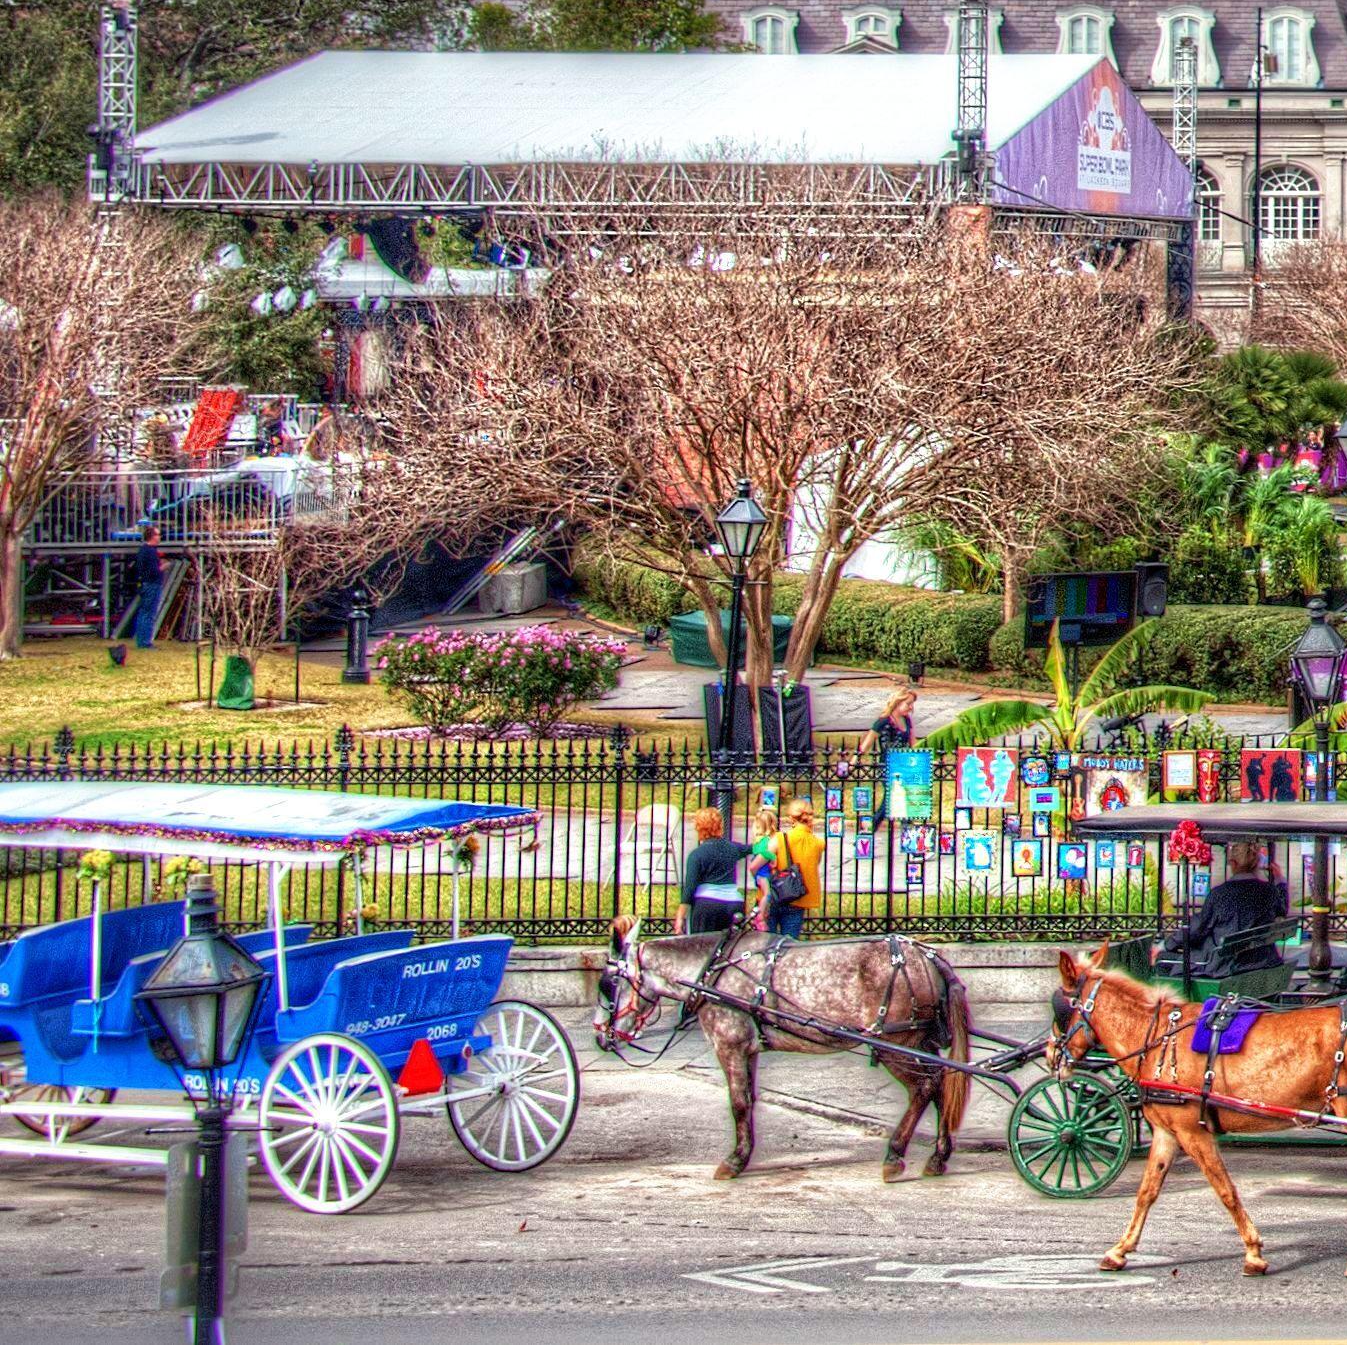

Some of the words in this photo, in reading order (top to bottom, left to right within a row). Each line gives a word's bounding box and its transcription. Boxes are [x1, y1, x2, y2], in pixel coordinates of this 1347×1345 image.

[402, 958, 450, 978] ROLLIN
[455, 954, 482, 971] 20'S
[426, 1022, 458, 1041] 2068
[184, 1073, 228, 1091] ROLIN
